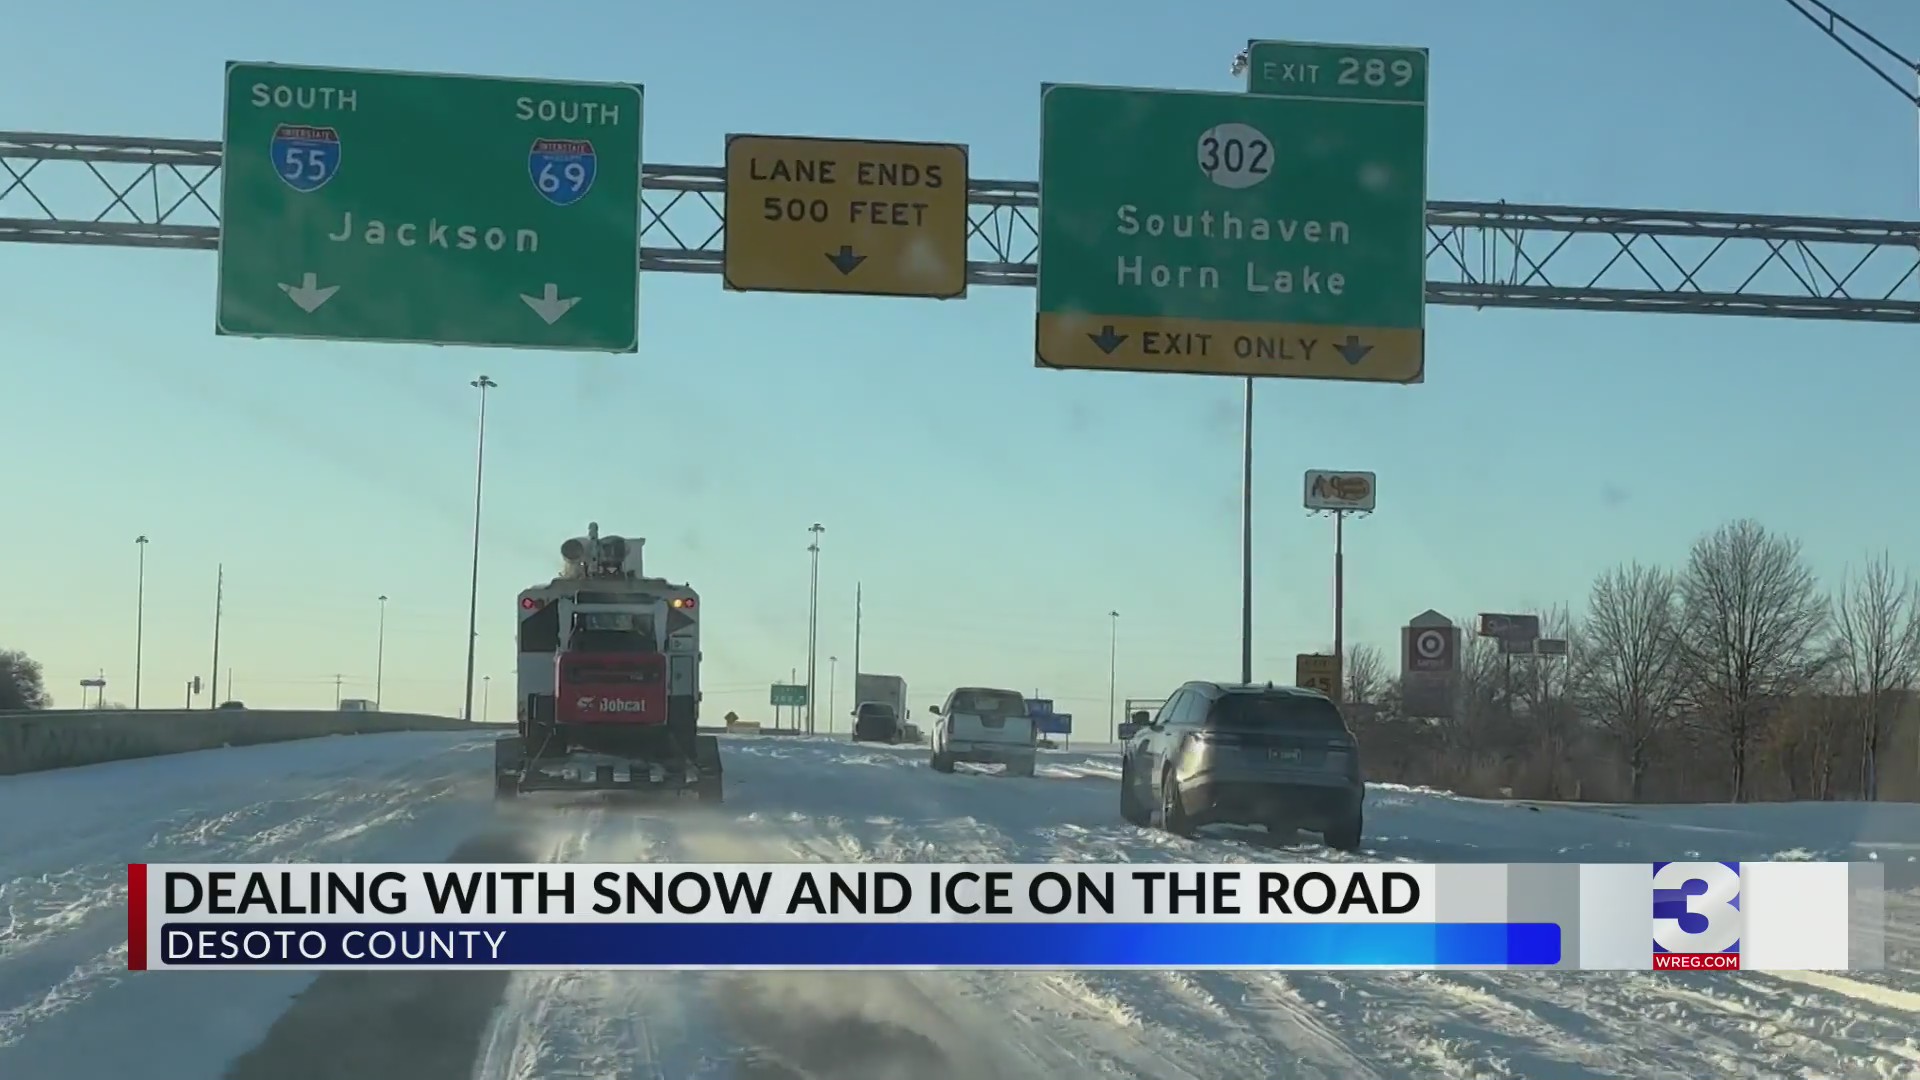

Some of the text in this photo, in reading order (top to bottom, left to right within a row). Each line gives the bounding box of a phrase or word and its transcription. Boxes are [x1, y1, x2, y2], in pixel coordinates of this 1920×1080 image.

[1263, 57, 1413, 87] EXIT 289
[251, 82, 358, 112] SOUTH
[515, 96, 620, 126] SOUTH
[284, 147, 326, 181] 55
[1200, 137, 1269, 175] 302
[538, 162, 586, 193] 69
[750, 158, 942, 189] LANE ENDS
[763, 197, 929, 227] 500 FEET
[1116, 205, 1350, 245] Southaven
[328, 211, 539, 252] Jackson
[1116, 256, 1346, 296] Horn Lake
[1142, 331, 1319, 362] EXIT ONLY
[600, 698, 646, 713] Bobcat
